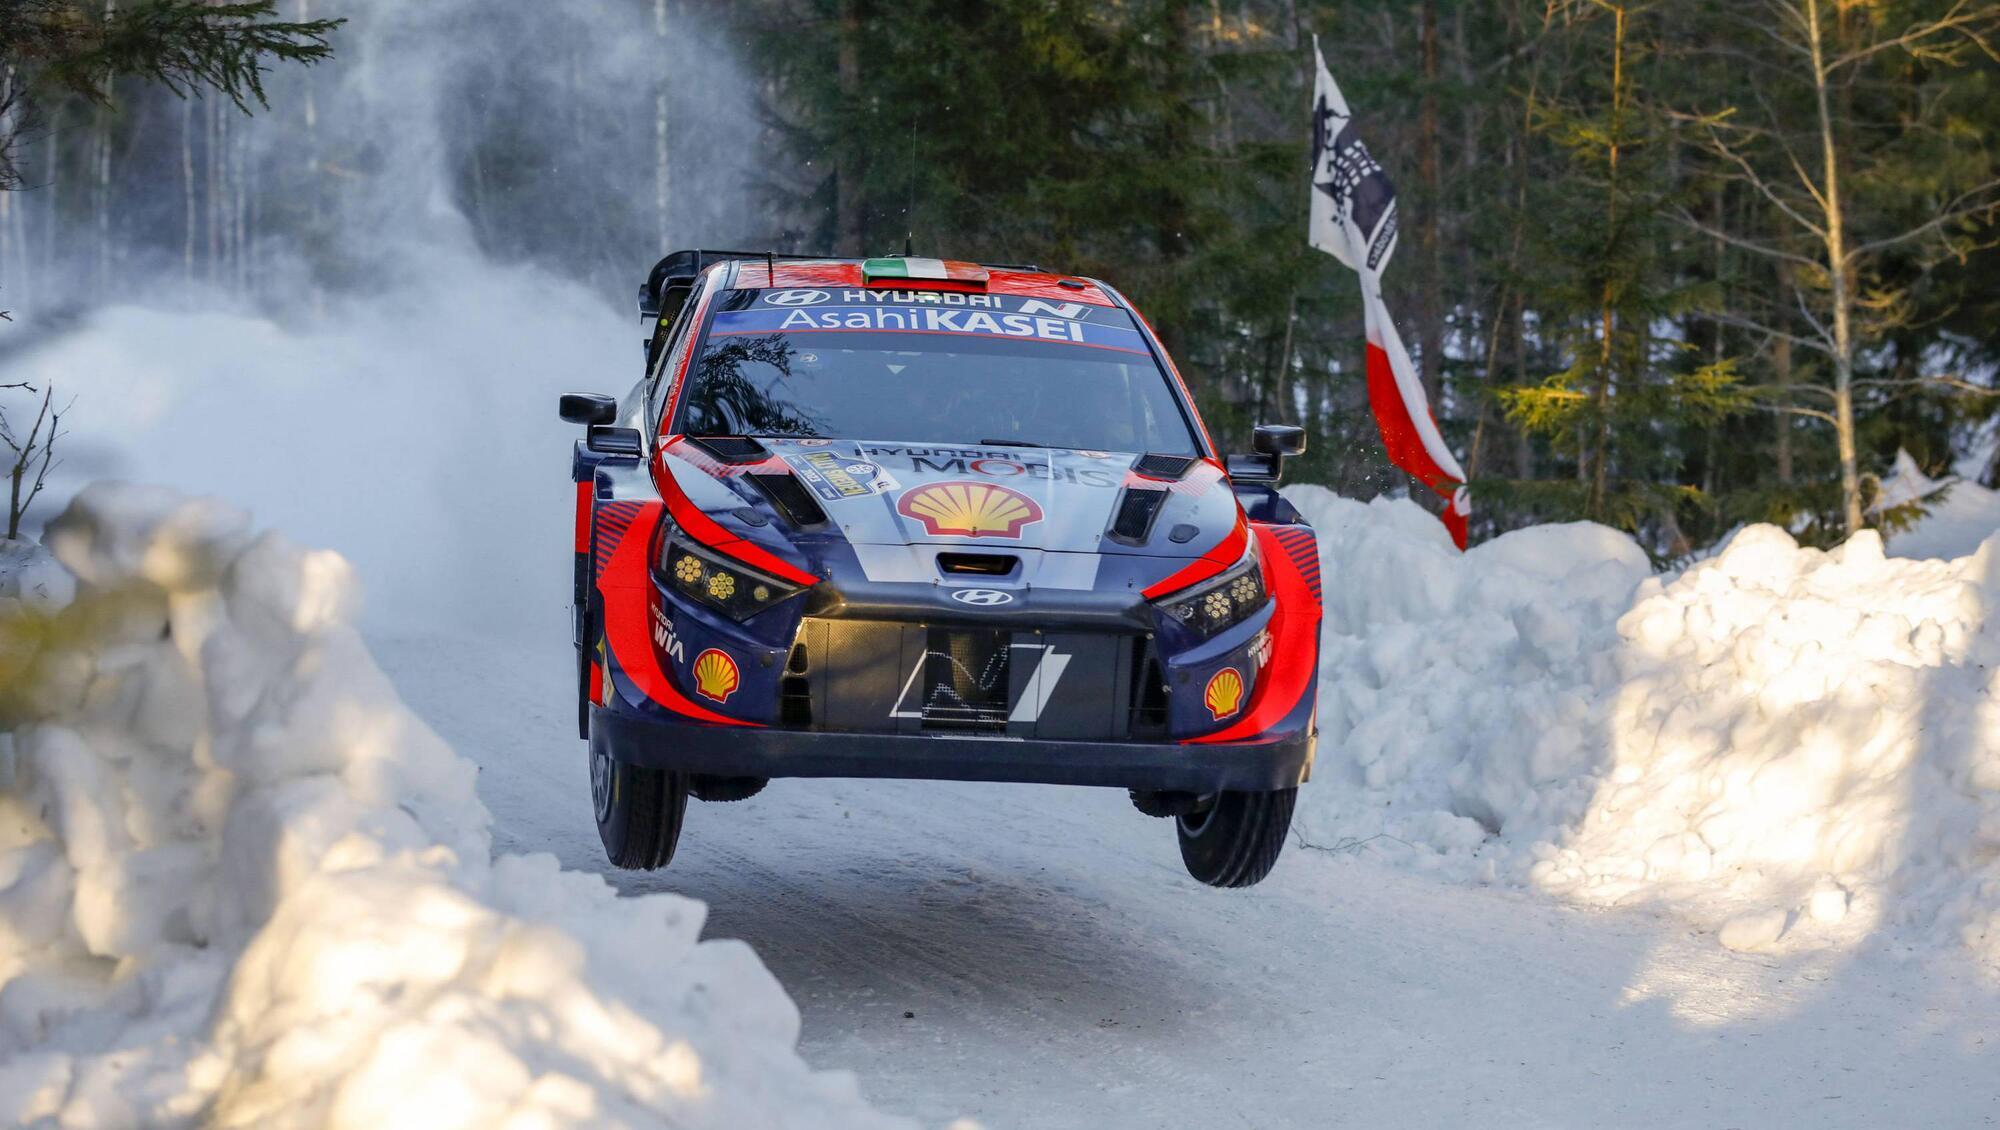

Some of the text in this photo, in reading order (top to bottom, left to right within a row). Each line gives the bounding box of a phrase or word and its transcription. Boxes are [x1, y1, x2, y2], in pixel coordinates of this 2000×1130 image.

[843, 289, 1002, 308] HYUNDAI
[854, 448, 1021, 460] HYUNDAI
[911, 456, 1118, 488] MOBIS
